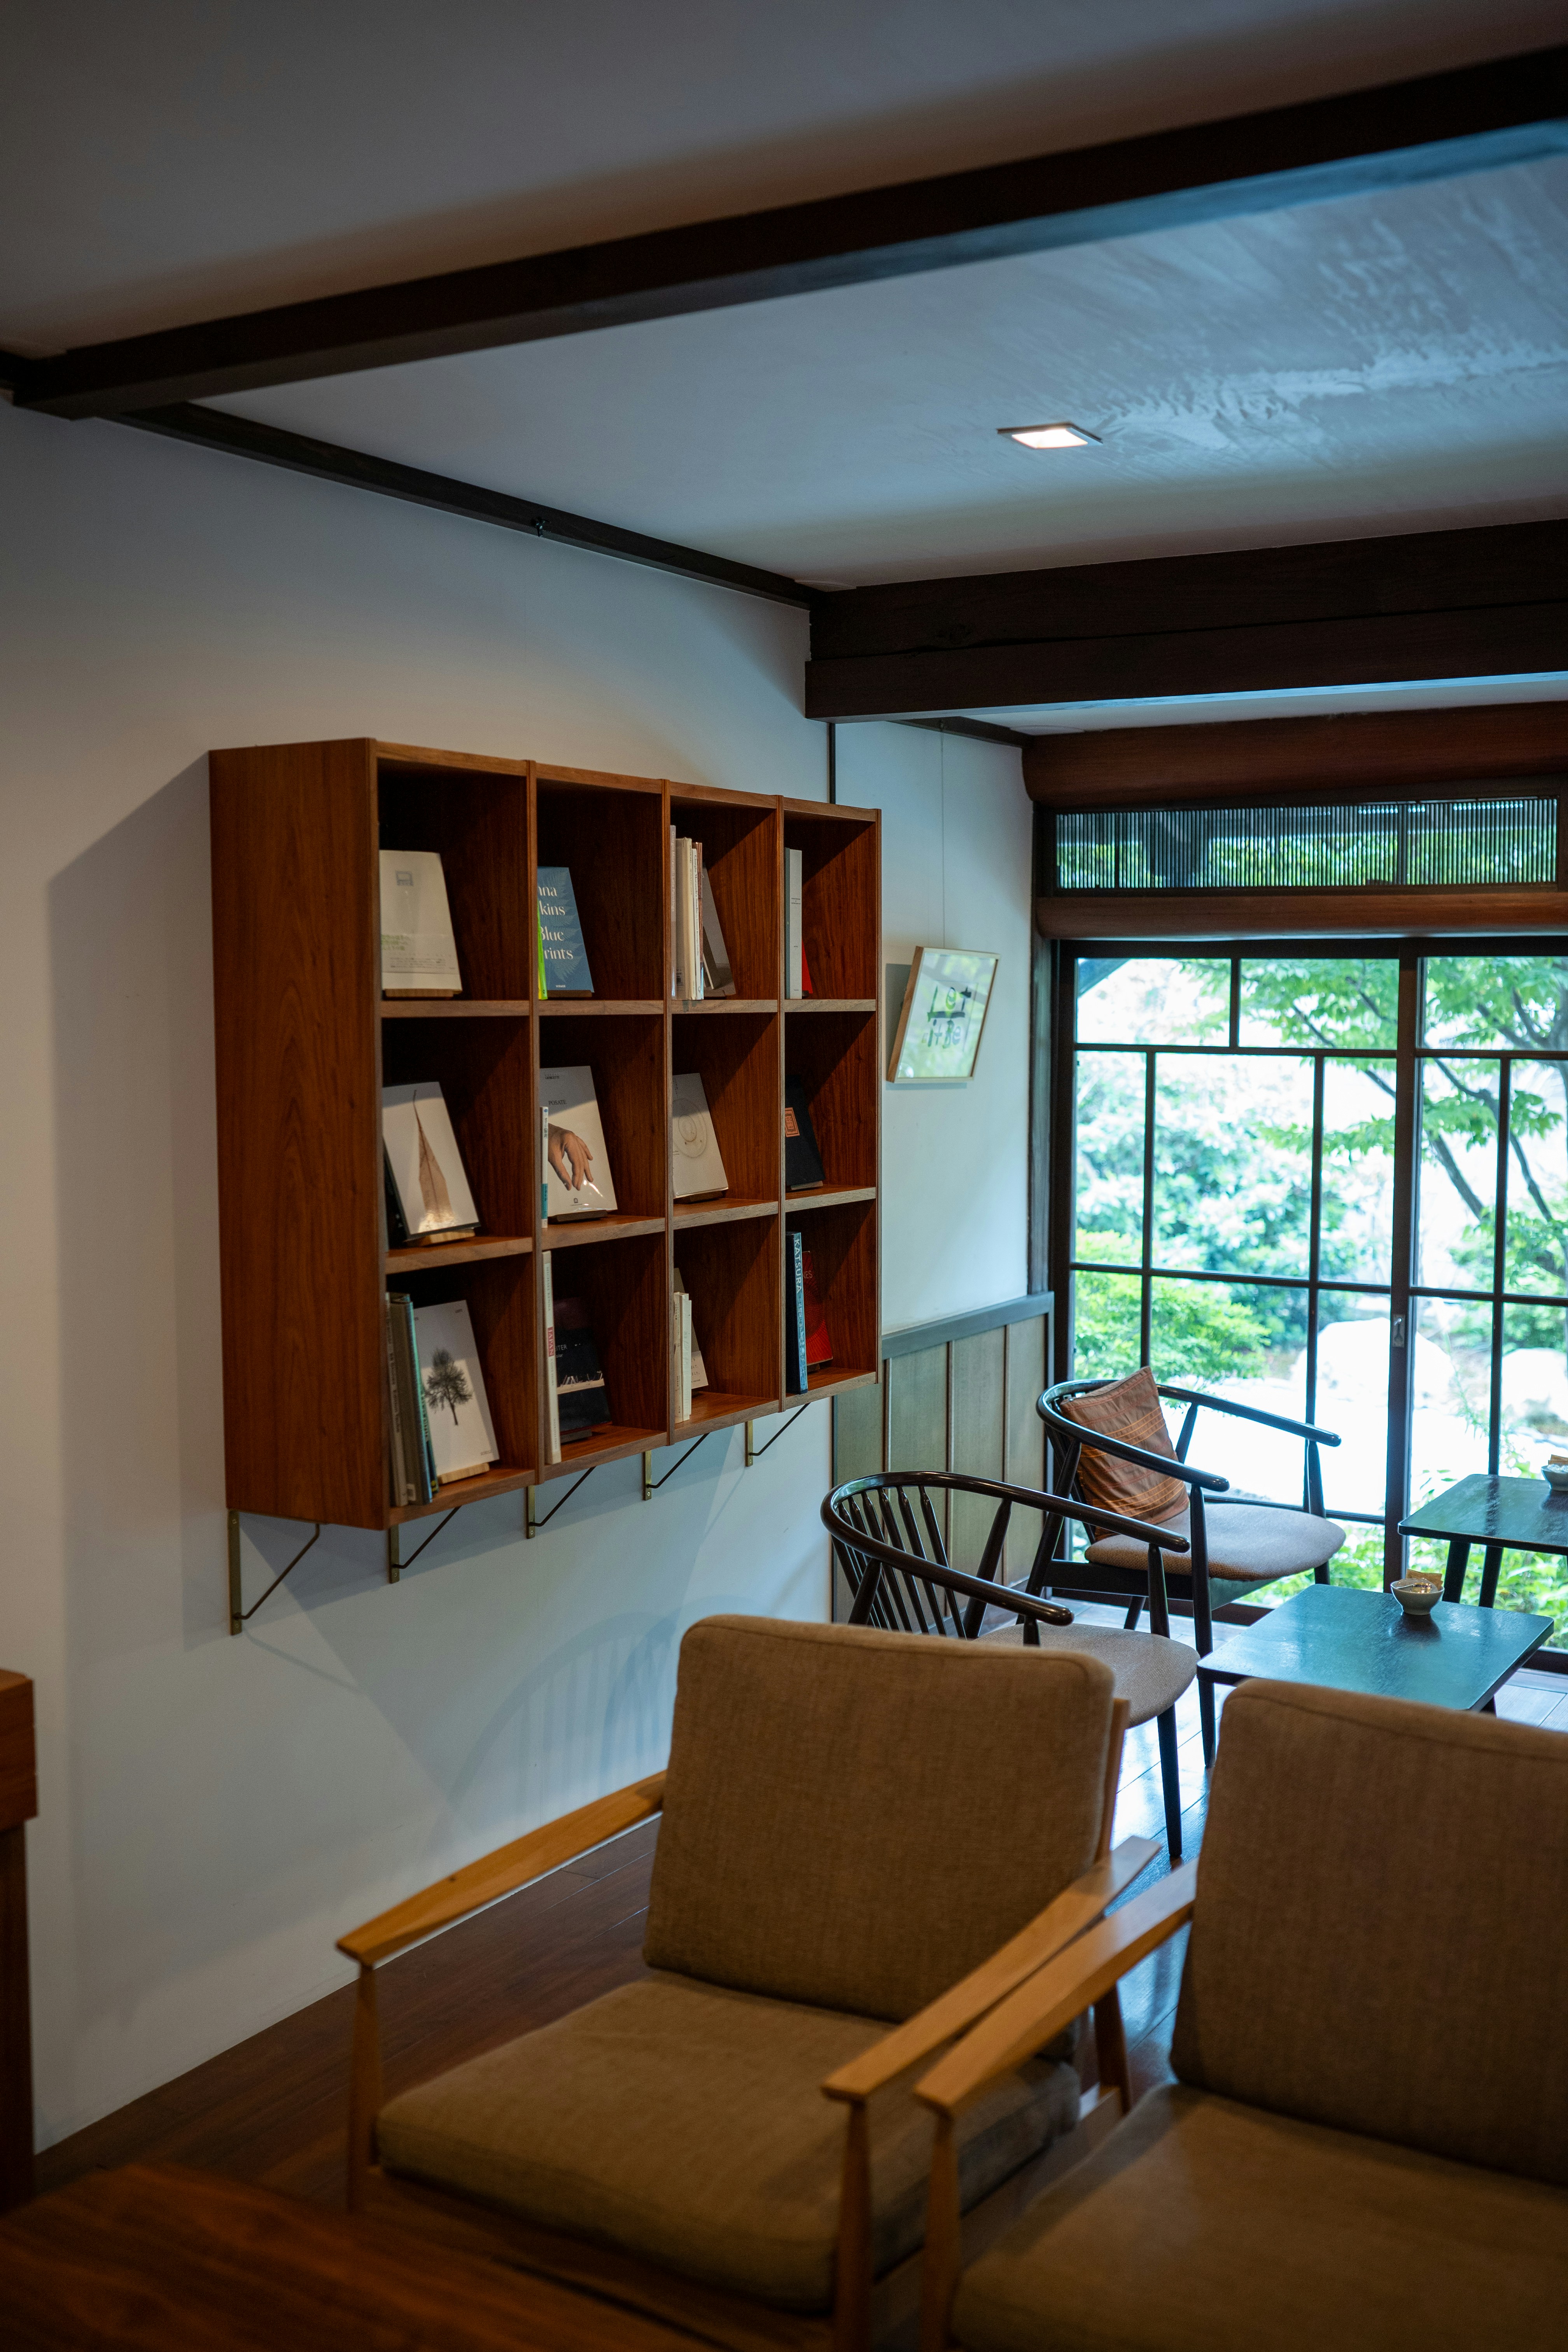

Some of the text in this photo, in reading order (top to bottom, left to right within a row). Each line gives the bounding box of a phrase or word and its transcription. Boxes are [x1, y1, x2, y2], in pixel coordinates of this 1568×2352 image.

[539, 900, 565, 915] kins
[540, 926, 565, 941] Blue
[543, 947, 573, 959] rints
[927, 985, 971, 1022] Let
[928, 1019, 961, 1049] it Be
